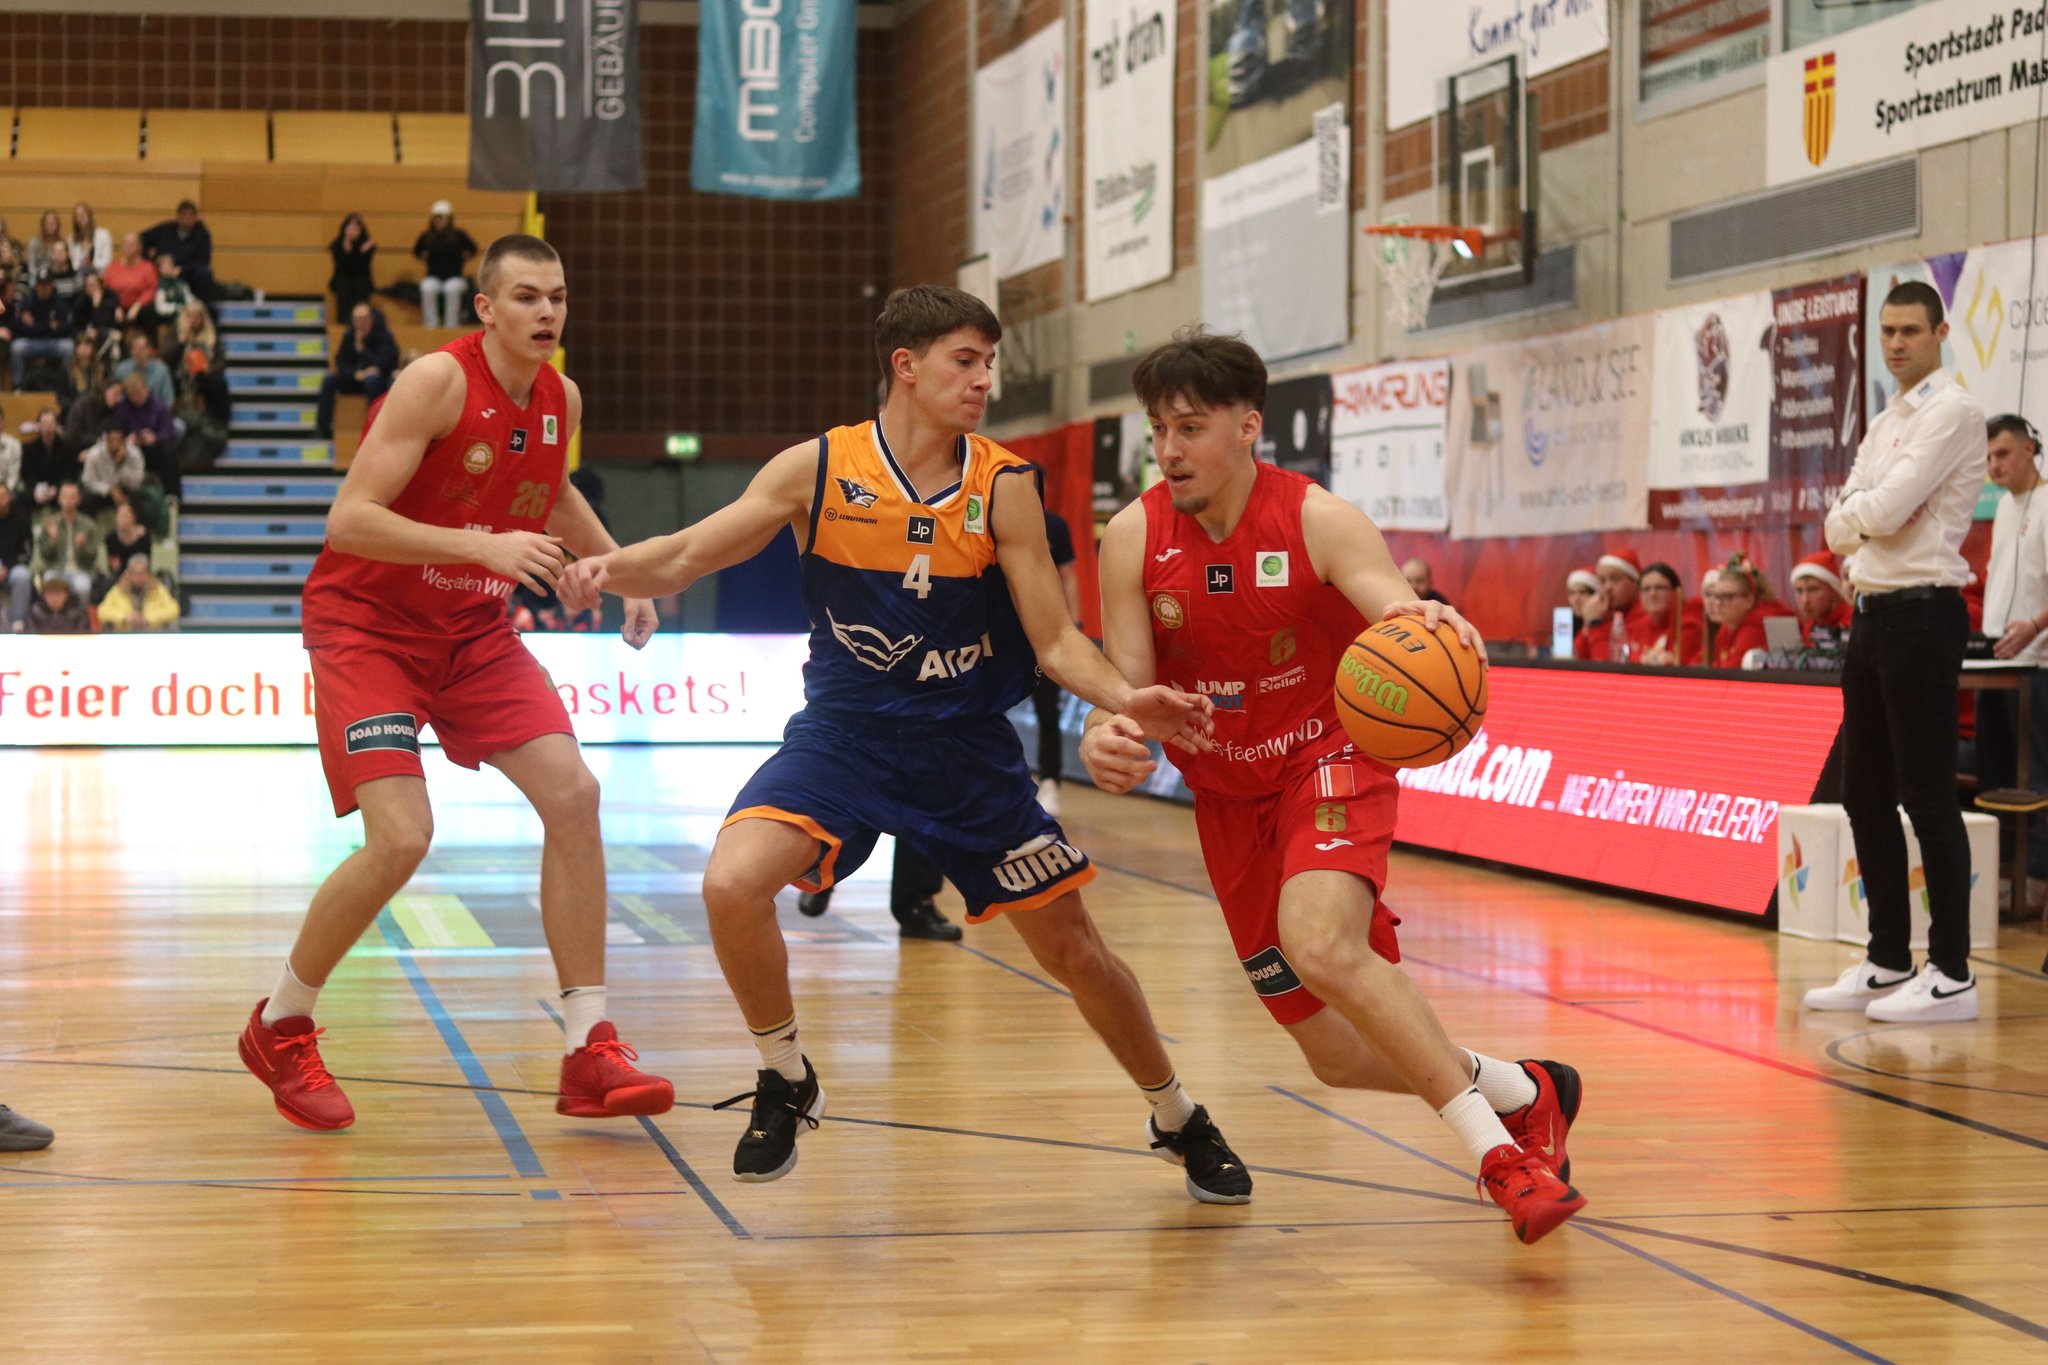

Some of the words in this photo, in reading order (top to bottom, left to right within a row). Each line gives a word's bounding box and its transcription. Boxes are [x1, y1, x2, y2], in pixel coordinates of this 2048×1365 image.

[595, 0, 625, 120] GEBÄU
[1904, 14, 2005, 79] Sportstadt
[2011, 7, 2048, 39] Pad
[1875, 73, 2002, 134] Sportzentrum
[508, 480, 550, 519] 26
[902, 554, 932, 599] 4
[1269, 627, 1296, 666] 6
[0, 670, 129, 718] Feier
[151, 672, 280, 716] doch
[556, 671, 747, 715] askets!
[1341, 652, 1408, 715] Wilson
[349, 725, 382, 741] ROAD
[1314, 802, 1347, 833] 6
